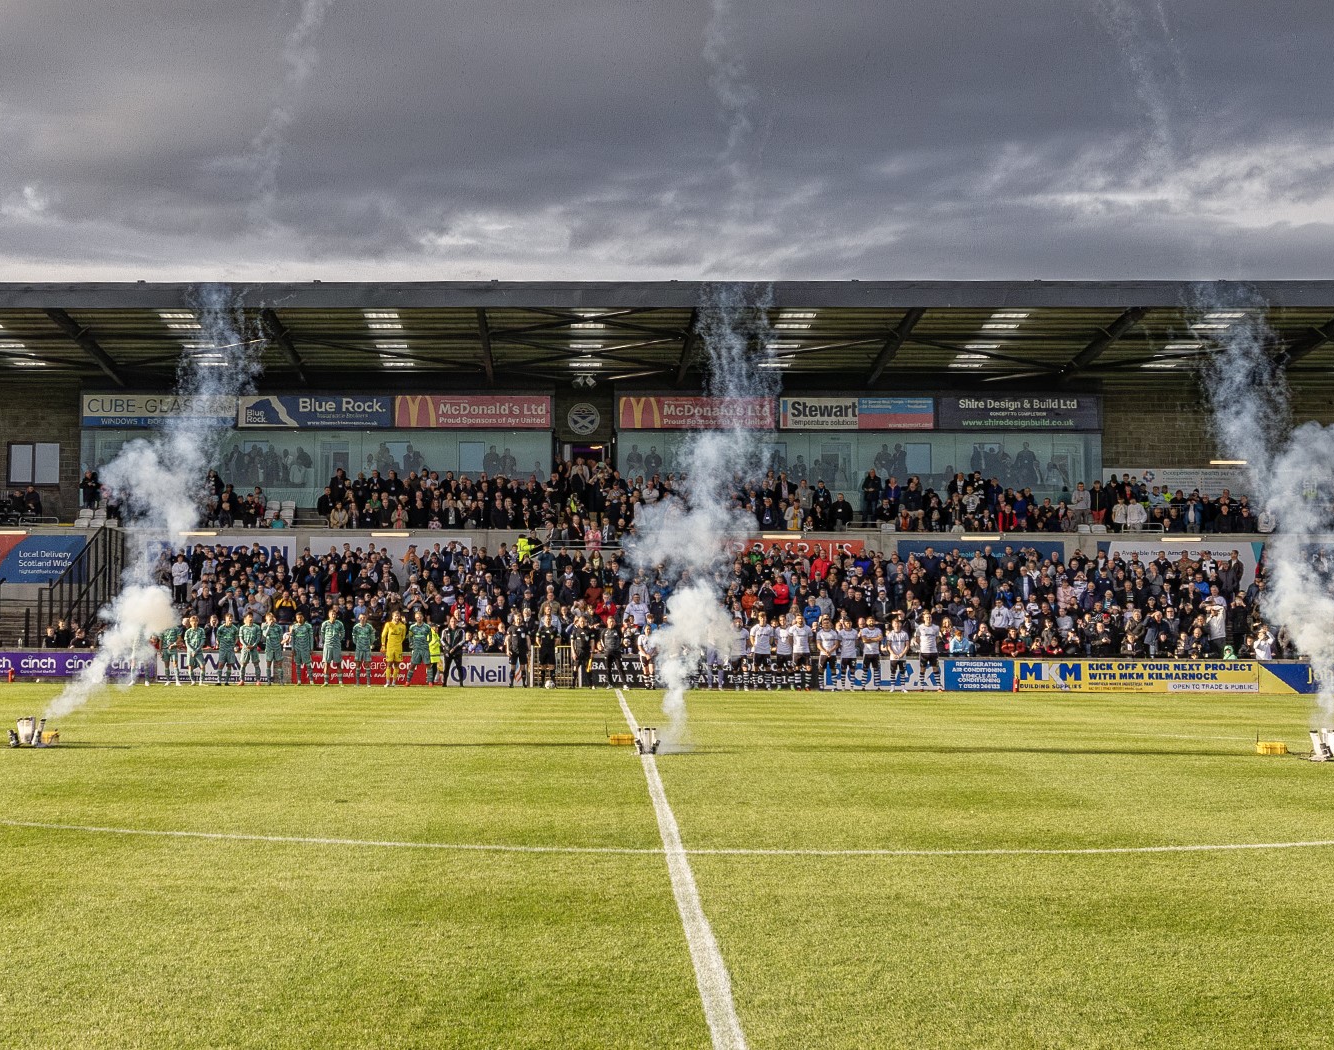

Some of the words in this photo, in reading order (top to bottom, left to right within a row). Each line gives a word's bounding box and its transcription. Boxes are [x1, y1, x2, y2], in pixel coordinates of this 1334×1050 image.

[299, 398, 339, 412] Blue
[342, 398, 386, 412] Rock.
[439, 403, 520, 415] McDonald's
[523, 403, 546, 415] Ltd
[663, 403, 744, 416] McDonald's
[747, 404, 770, 416] Ltd
[791, 401, 857, 417] Stewart
[959, 399, 985, 409] Shire
[987, 399, 1020, 410] Design
[1023, 400, 1031, 409] &
[1033, 399, 1058, 409] Build
[1060, 399, 1077, 409] Ltd
[462, 417, 496, 425] Sponsors
[507, 417, 519, 425] Ayr
[962, 419, 1074, 427] www.shiredesignbuild.co.uk
[19, 550, 39, 558] Local
[40, 550, 71, 559] Delivery
[18, 559, 51, 567] Scotland
[21, 655, 56, 669] cinch
[1088, 663, 1113, 671] KICK
[1117, 663, 1137, 671] OFF
[1141, 663, 1170, 671] YOUR
[1173, 663, 1199, 671] NEXT
[1204, 663, 1253, 672] PROJECT
[451, 665, 507, 683] O'Neil
[1020, 662, 1082, 690] MKM
[1148, 672, 1218, 680] KILMARNOCK
